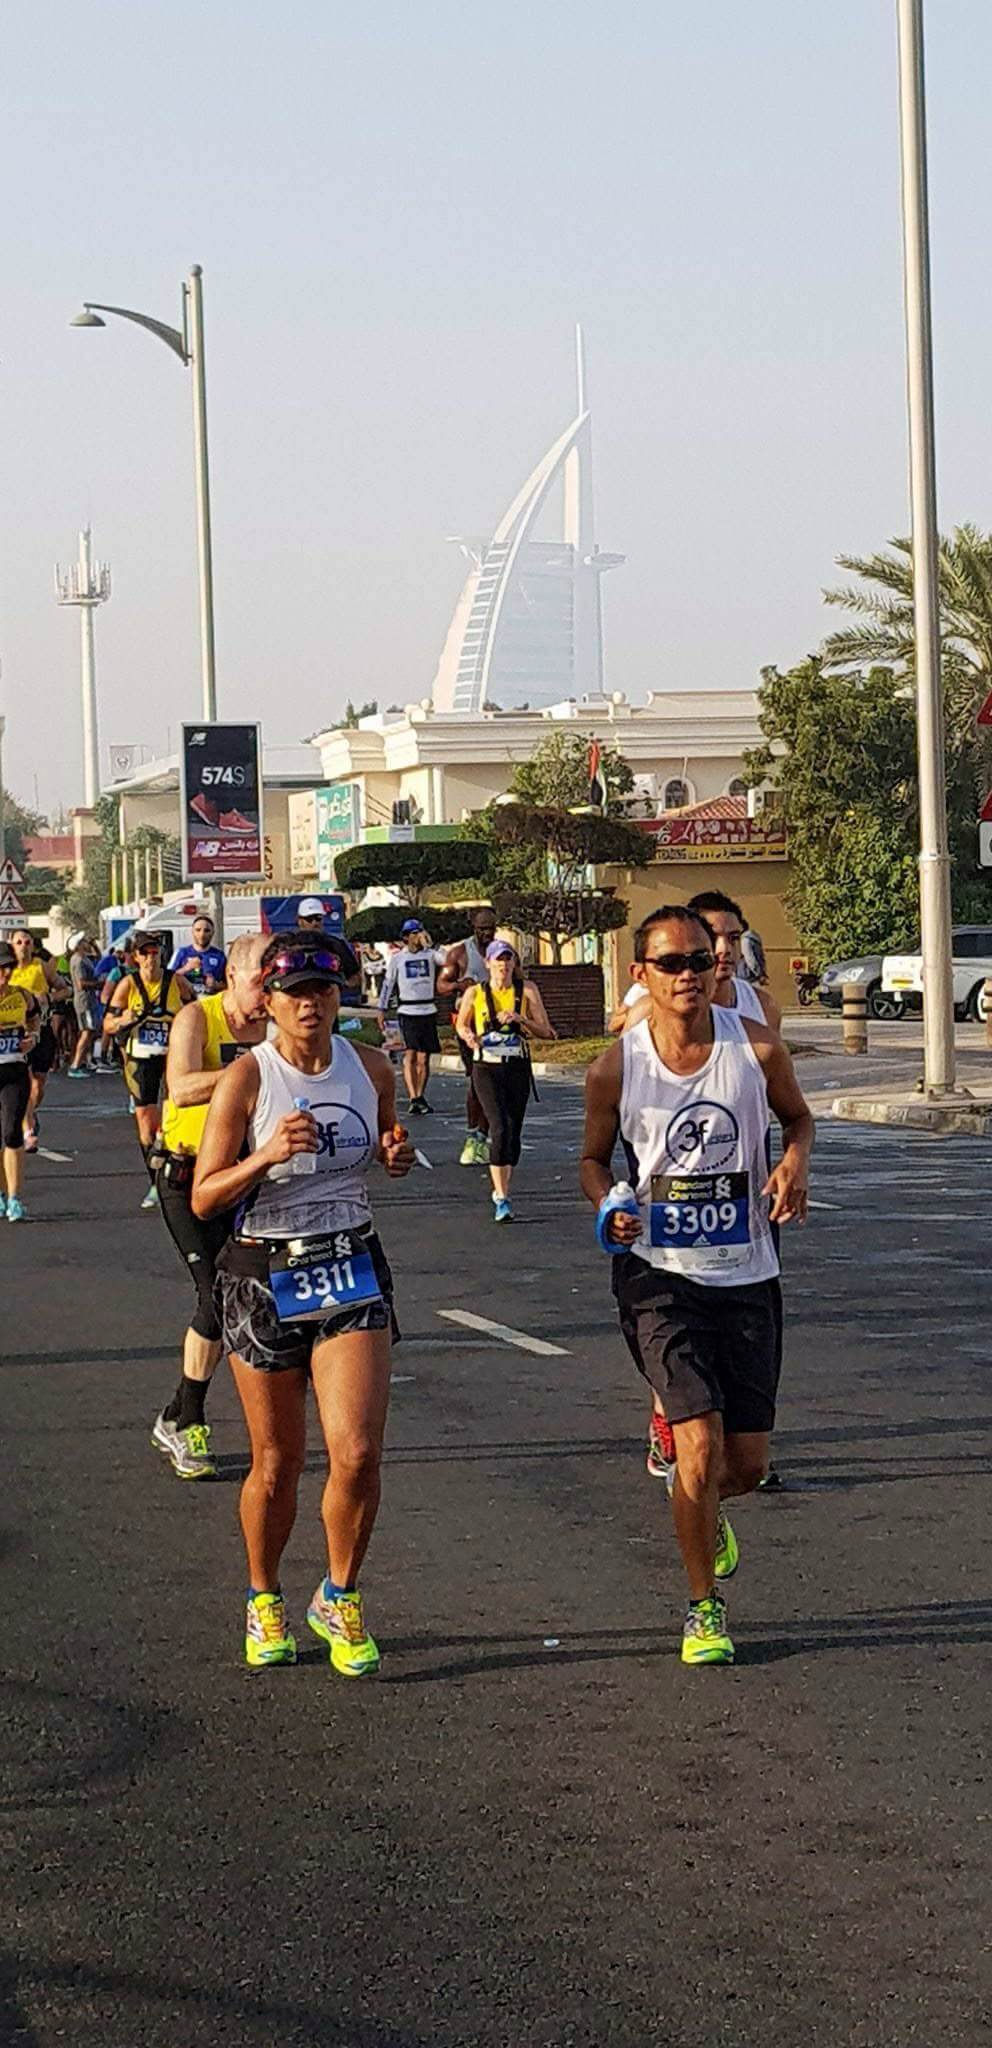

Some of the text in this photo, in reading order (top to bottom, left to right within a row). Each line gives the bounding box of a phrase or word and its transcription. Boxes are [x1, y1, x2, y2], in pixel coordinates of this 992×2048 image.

[201, 766, 245, 785] 574S
[663, 1203, 737, 1235] 3309
[288, 1239, 332, 1256] andard
[293, 1260, 356, 1300] 3311
